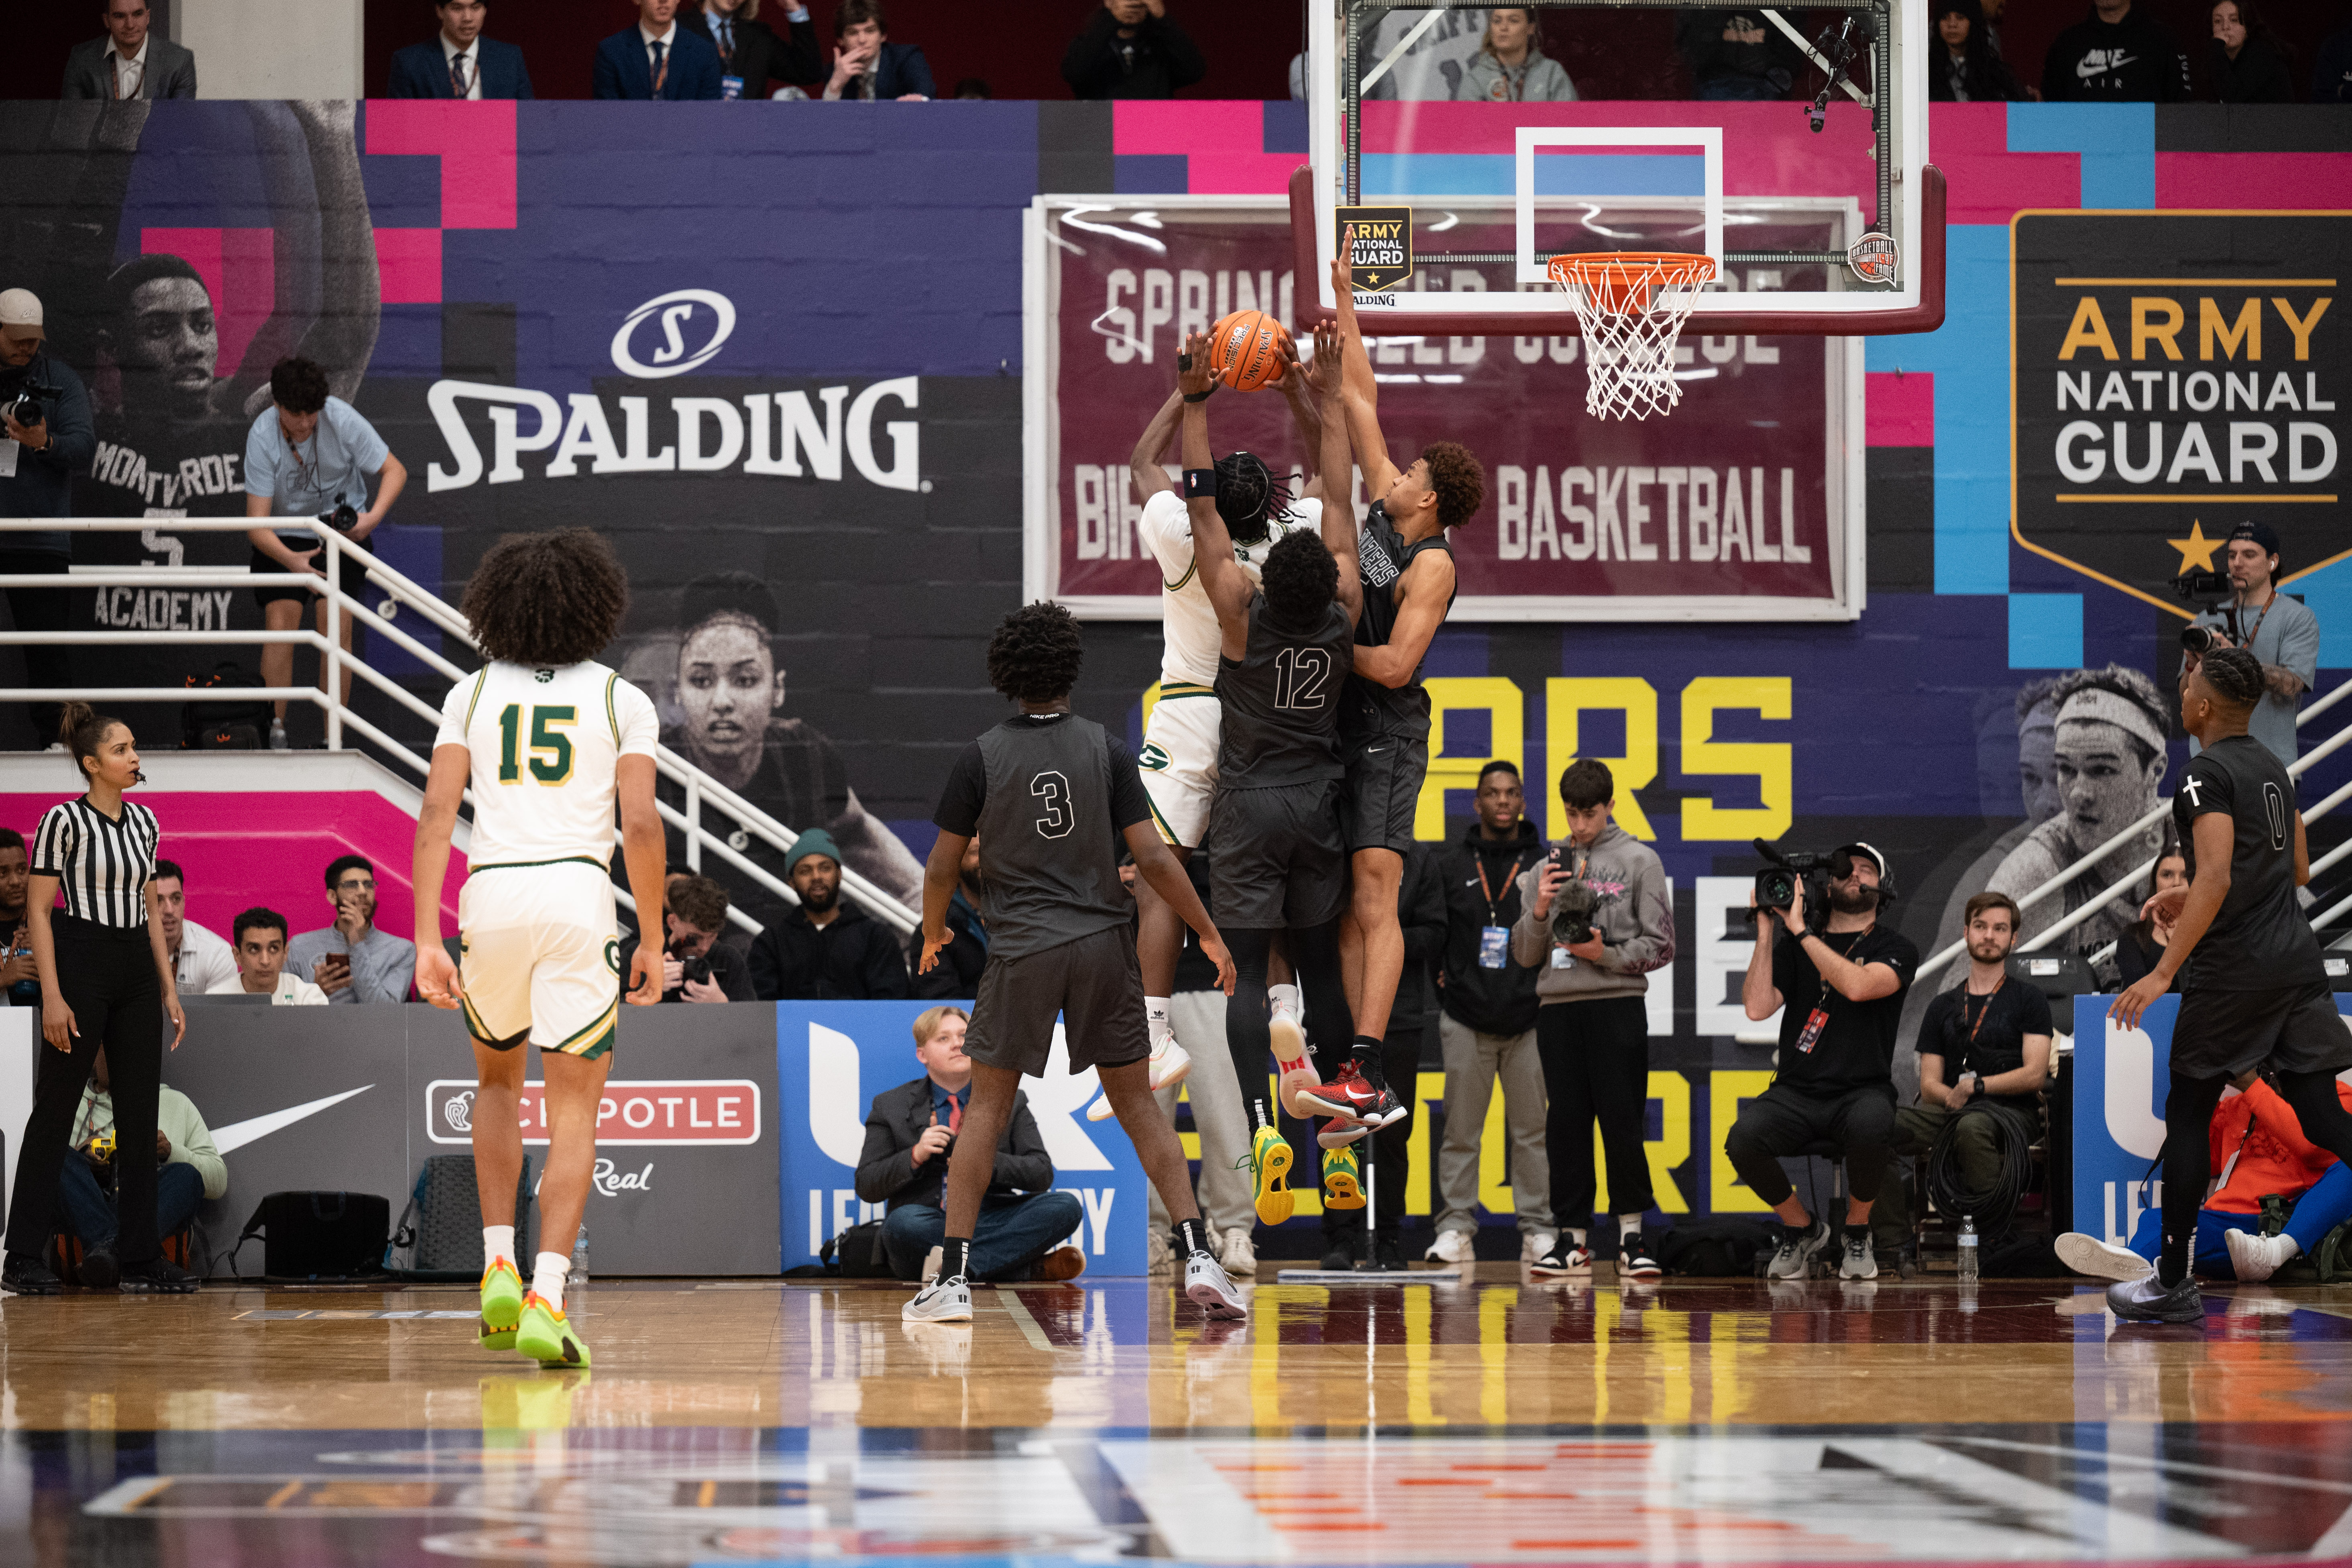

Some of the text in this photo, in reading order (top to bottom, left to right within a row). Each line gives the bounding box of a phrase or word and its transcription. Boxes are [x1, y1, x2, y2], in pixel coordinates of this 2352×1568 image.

[2083, 77, 2123, 89] AIR
[1352, 240, 1403, 249] ATIONAL
[1852, 240, 1893, 257] BASKETBALL
[1868, 254, 1894, 265] HALL OF
[1875, 263, 1894, 280] FAME
[1353, 294, 1395, 306] ALDING
[1229, 323, 1252, 373] PRECISION
[2057, 296, 2333, 361] ARMY
[1243, 328, 1274, 382] SPALDING
[2056, 371, 2336, 412] NATIONAL
[427, 375, 920, 493] SPALDING
[2055, 420, 2338, 484] GUARD
[1497, 465, 1812, 564] BASKETBALL
[95, 585, 233, 631] ACADEMY
[1274, 648, 1331, 709] 12
[498, 703, 580, 787] 15
[1030, 770, 1075, 839] 3
[2262, 781, 2287, 851] 0
[593, 1158, 654, 1197] Real
